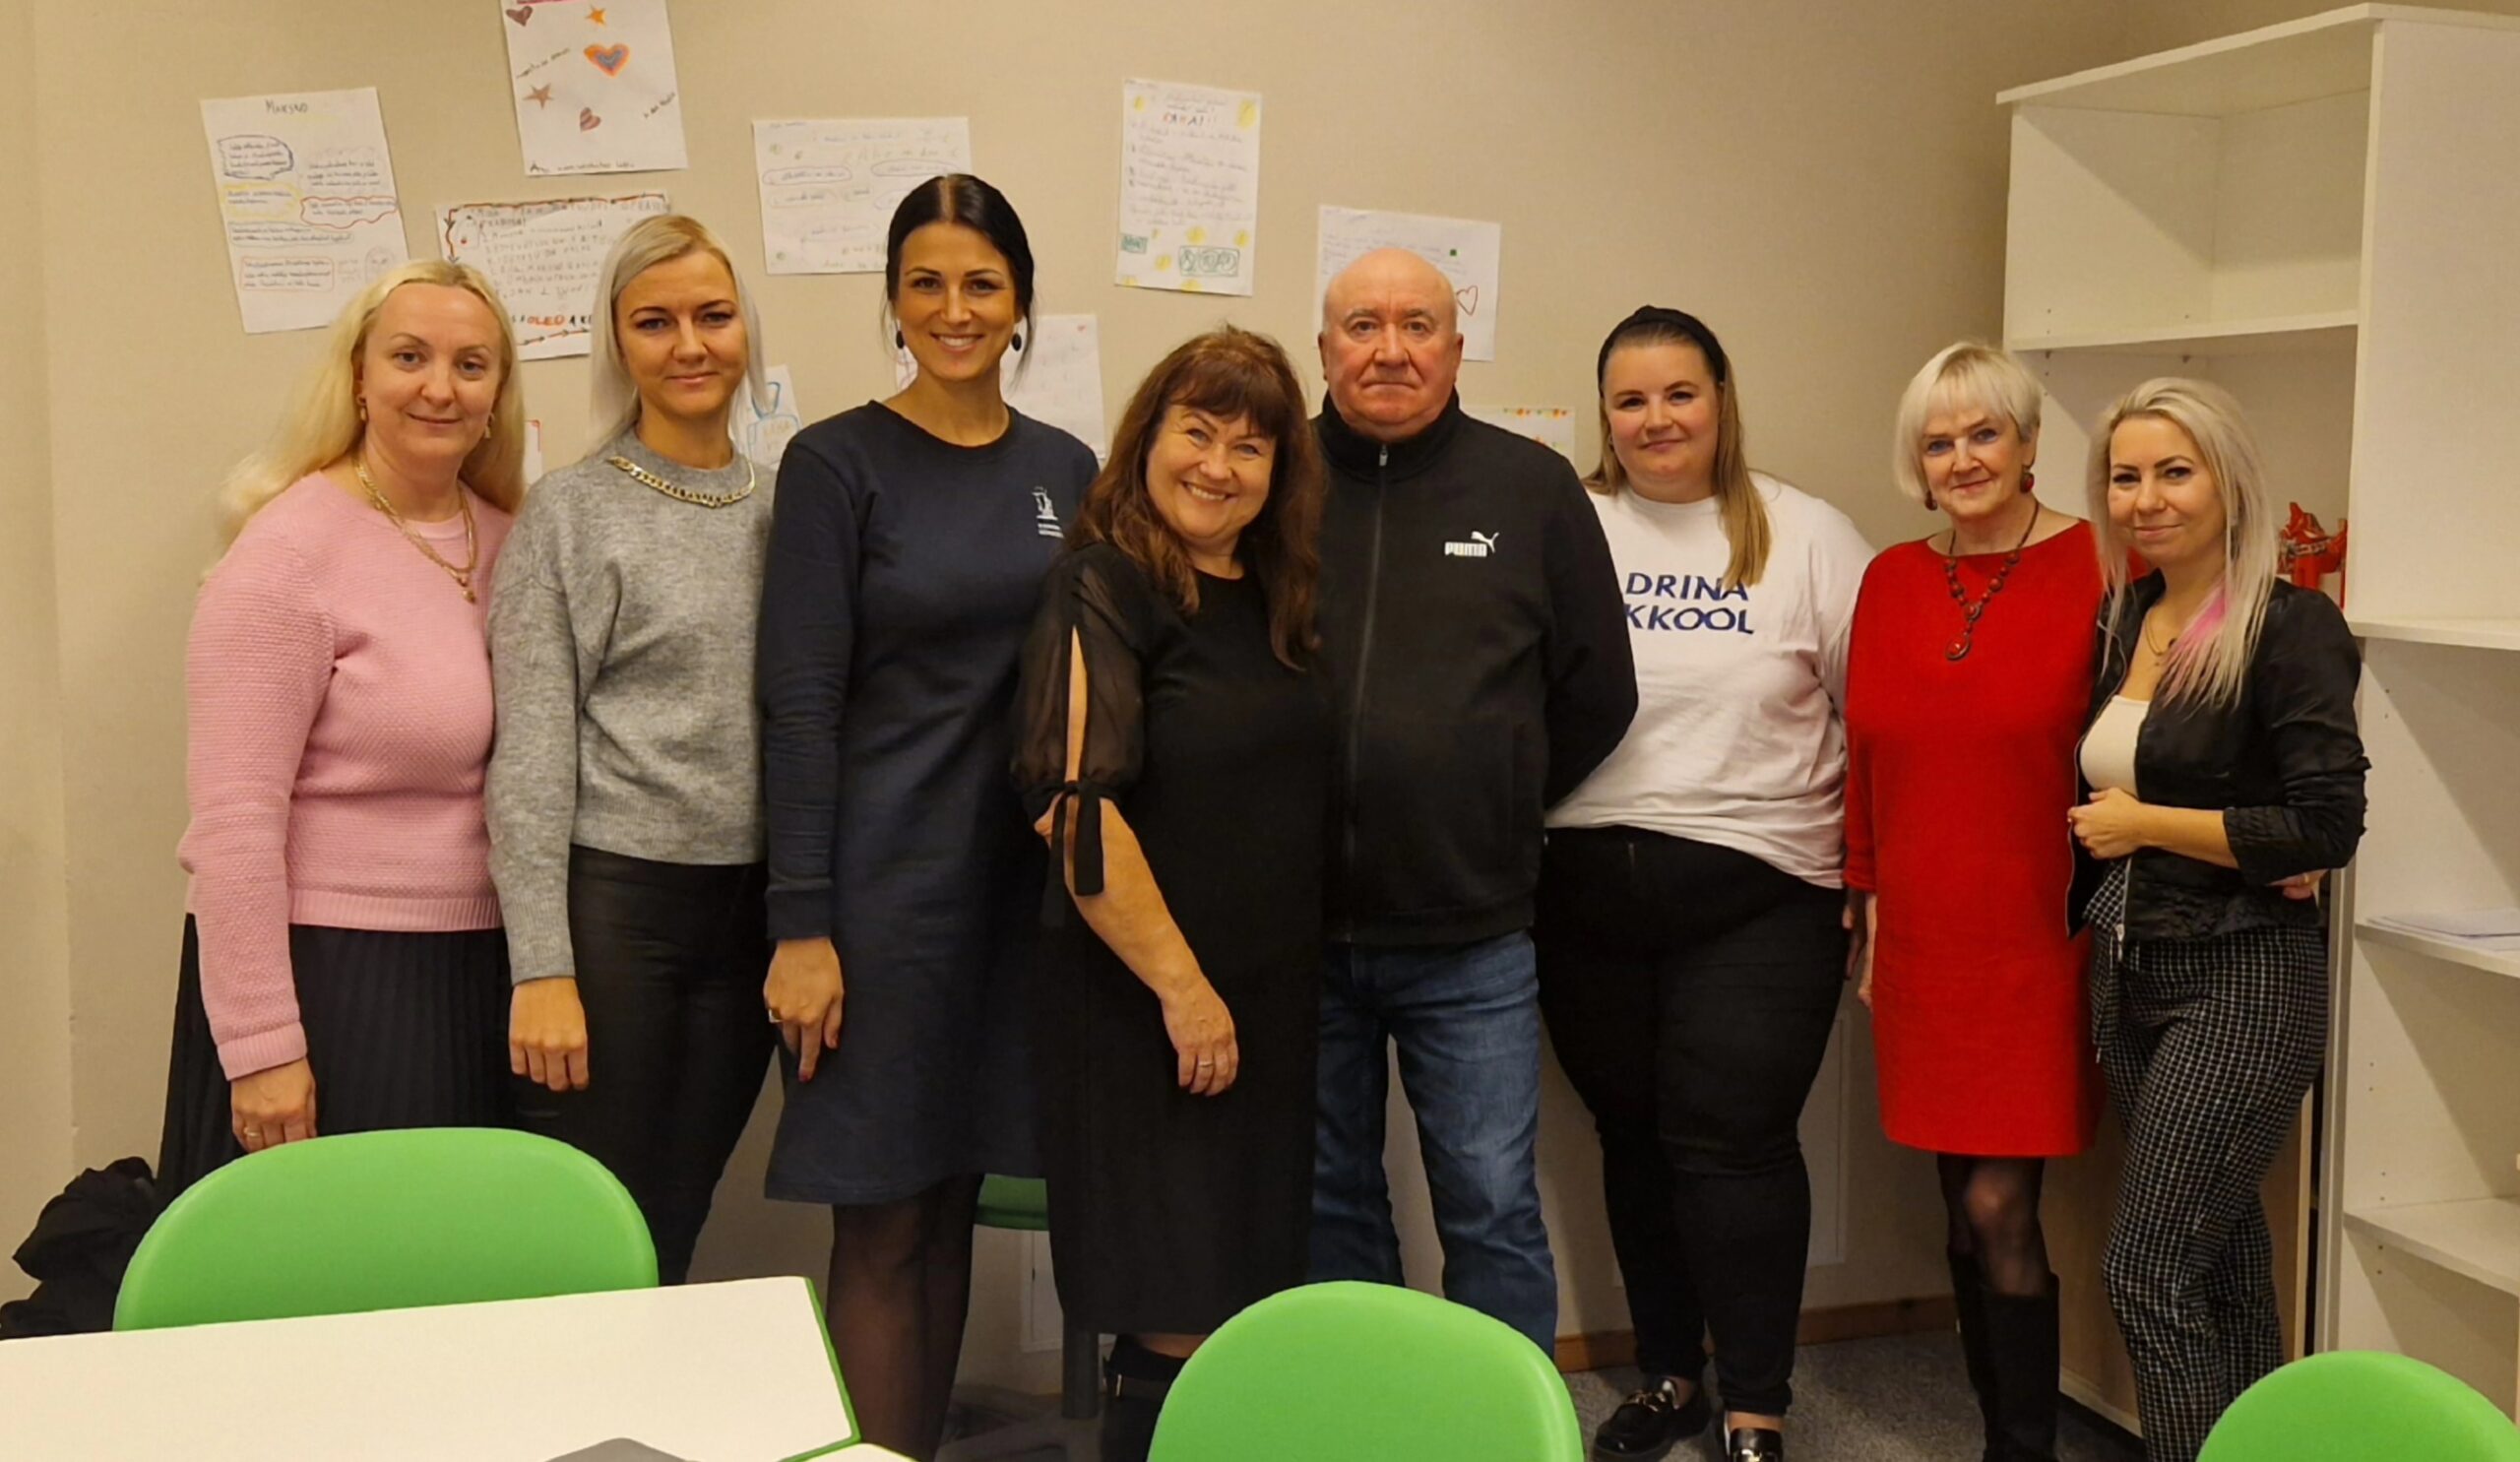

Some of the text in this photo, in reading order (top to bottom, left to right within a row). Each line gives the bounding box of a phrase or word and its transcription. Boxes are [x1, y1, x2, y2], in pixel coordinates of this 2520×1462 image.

[1444, 540, 1487, 557] PUMA
[1625, 572, 1749, 602] DRINA
[1624, 602, 1755, 635] KKOOL
